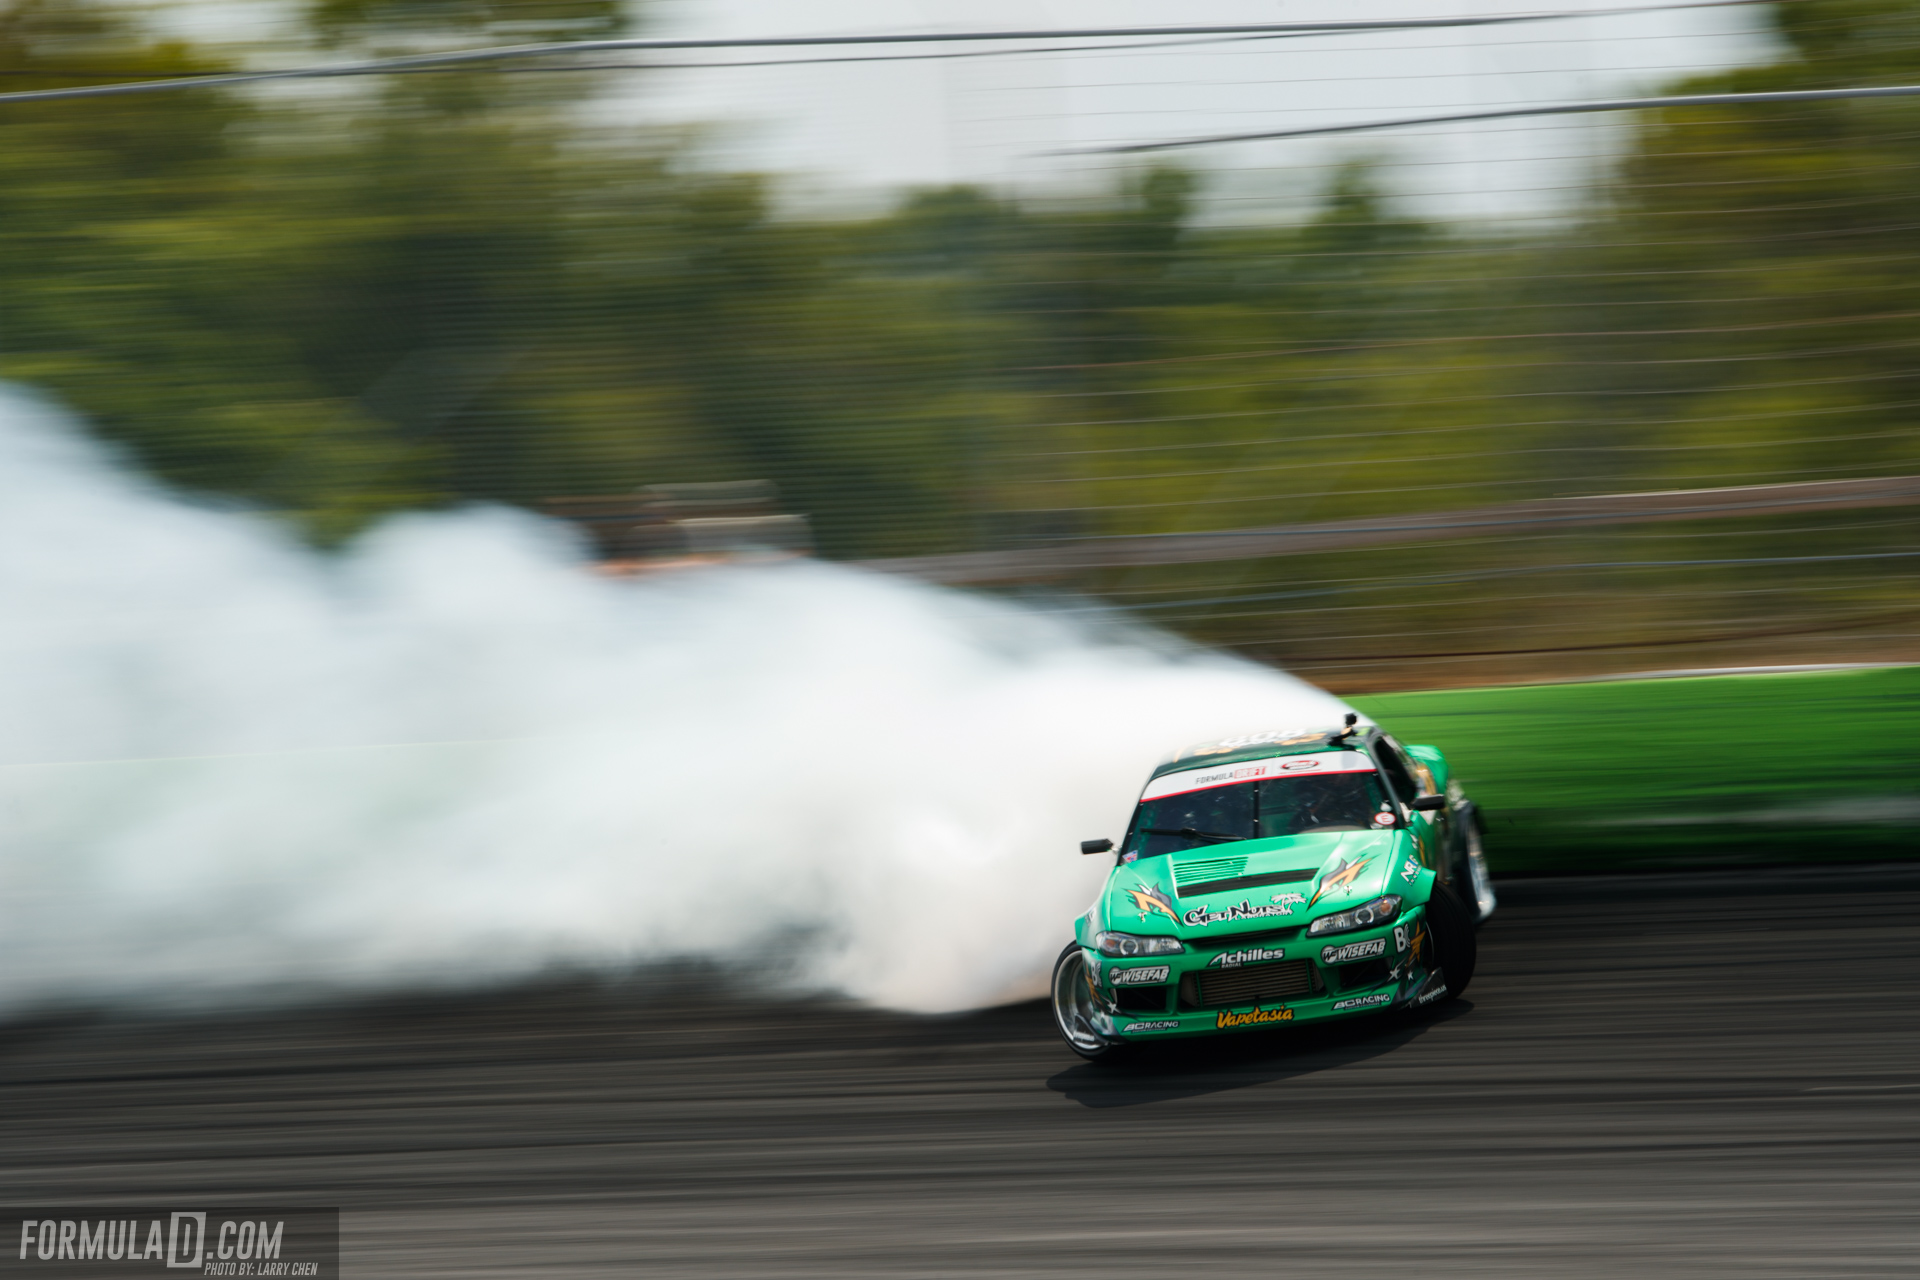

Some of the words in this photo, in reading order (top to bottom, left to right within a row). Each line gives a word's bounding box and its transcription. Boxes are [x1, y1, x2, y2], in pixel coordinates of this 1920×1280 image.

[1195, 772, 1234, 784] FORMULA
[1234, 766, 1266, 779] DRIFT
[1209, 948, 1285, 966] Achilles
[1338, 941, 1386, 959] WISEFAB
[1122, 968, 1170, 982] WISEFAB
[1217, 1005, 1294, 1028] Vapetasia
